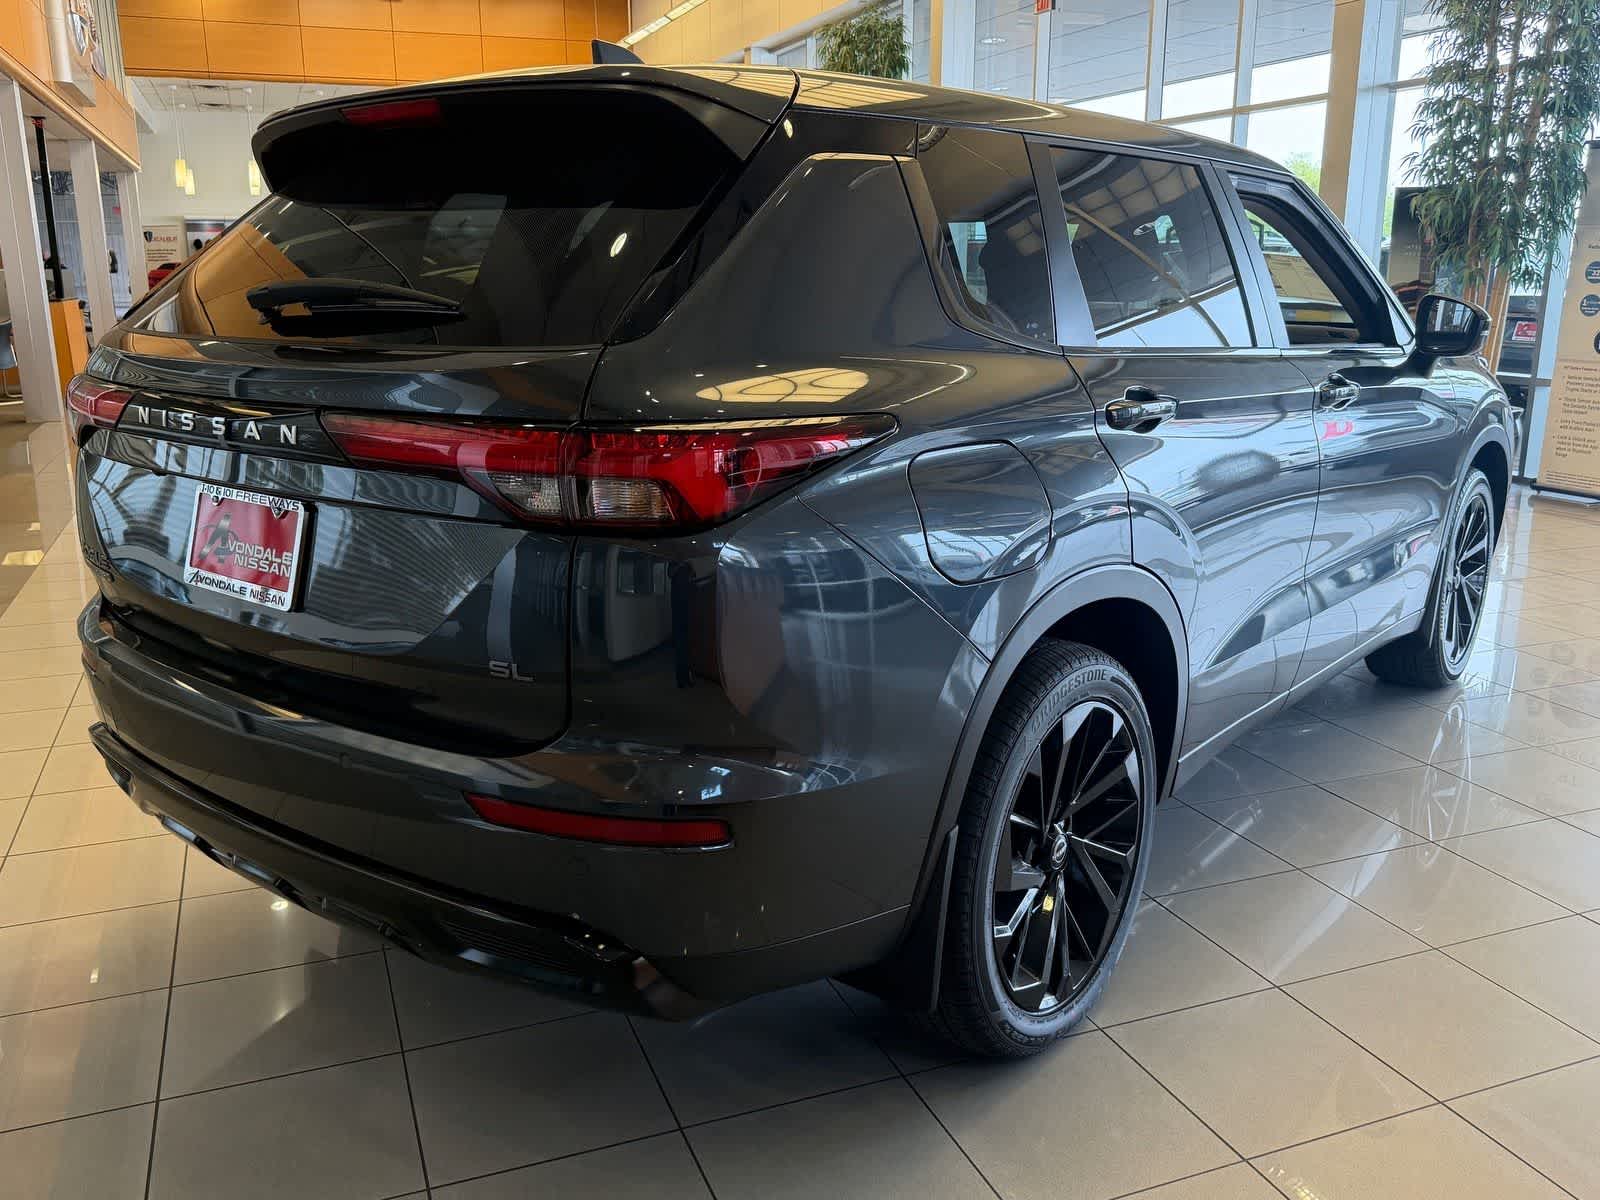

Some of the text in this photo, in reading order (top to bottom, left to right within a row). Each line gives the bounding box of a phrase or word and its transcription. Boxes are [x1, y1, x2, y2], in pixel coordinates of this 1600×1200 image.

[138, 406, 297, 445] NISSAN
[236, 489, 300, 511] FREEWAYS
[234, 553, 291, 577] NISSAN
[249, 588, 286, 607] NISSAN
[489, 660, 535, 682] SL
[1031, 668, 1108, 733] BRIDGESTONE
